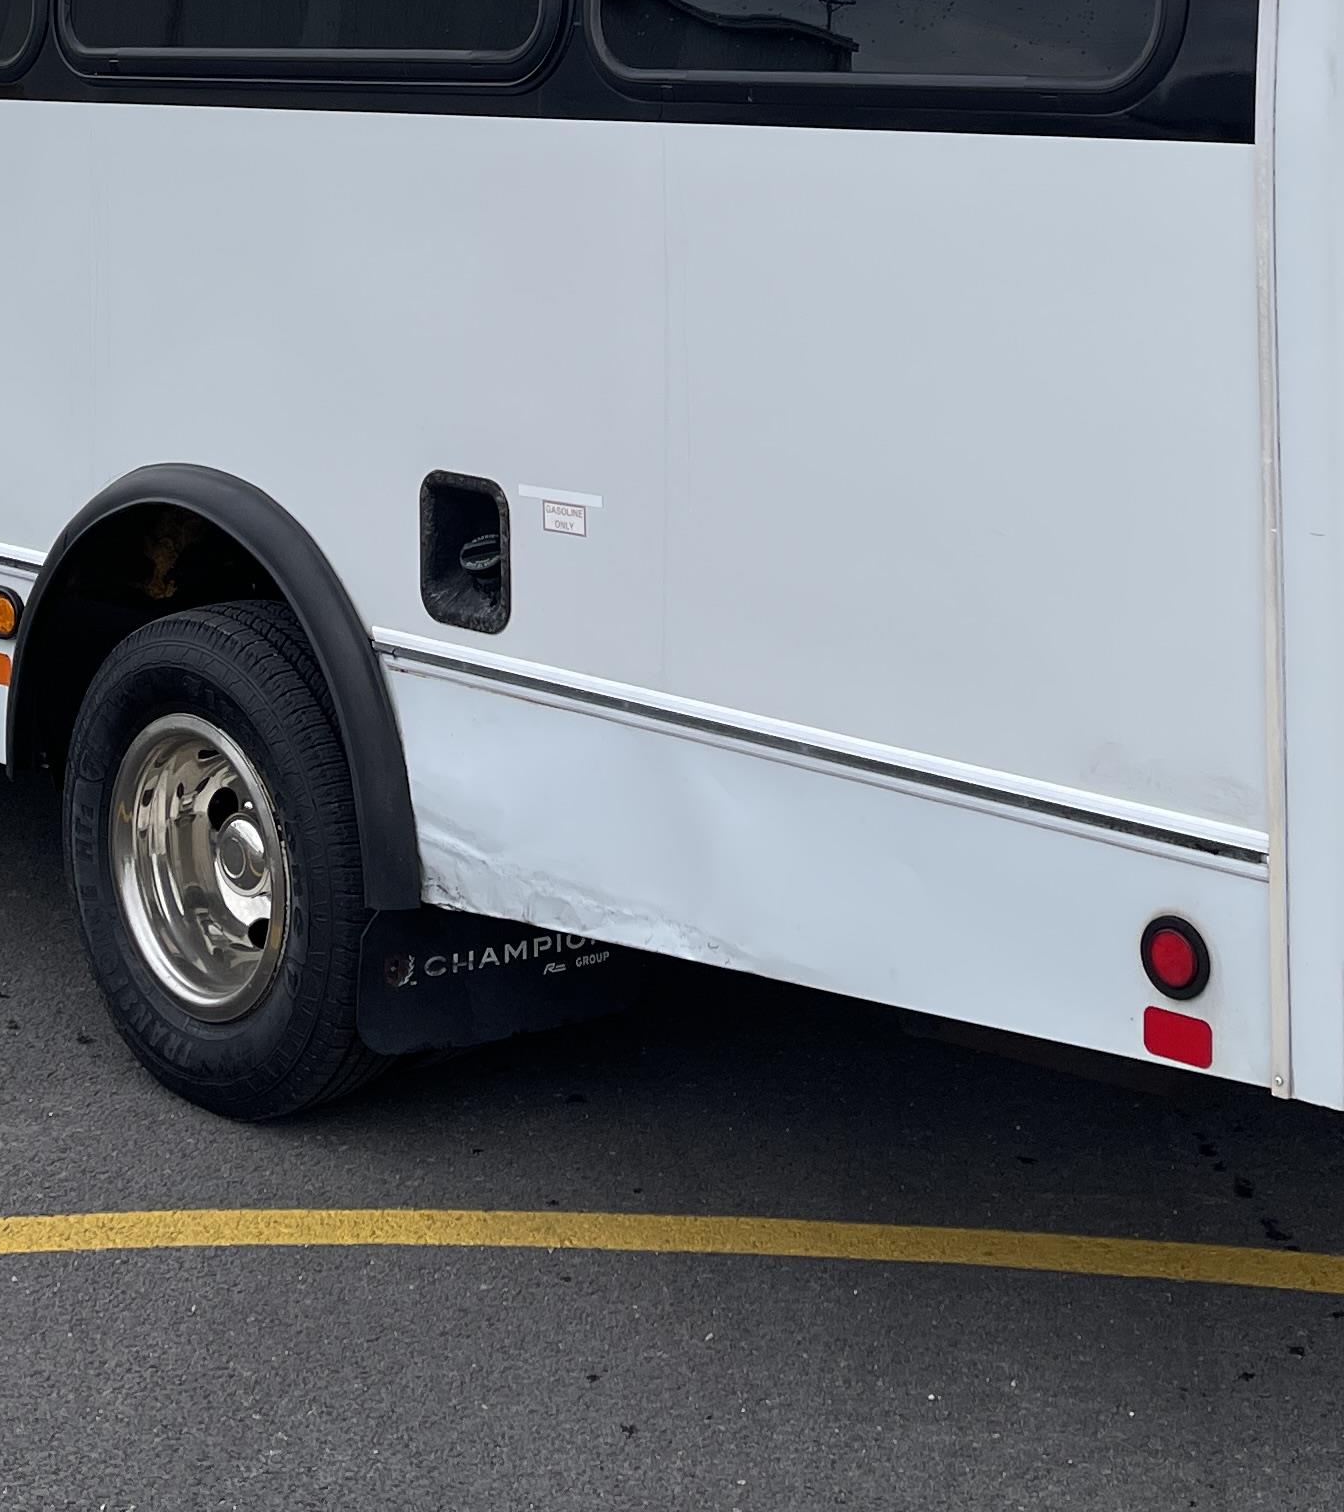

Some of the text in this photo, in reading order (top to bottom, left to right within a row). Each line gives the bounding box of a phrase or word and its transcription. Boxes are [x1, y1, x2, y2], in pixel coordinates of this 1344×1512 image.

[545, 504, 583, 519] GASOLINE
[554, 519, 575, 531] ONLY
[423, 932, 597, 978] CHAMPIO
[575, 950, 610, 968] GROUP
